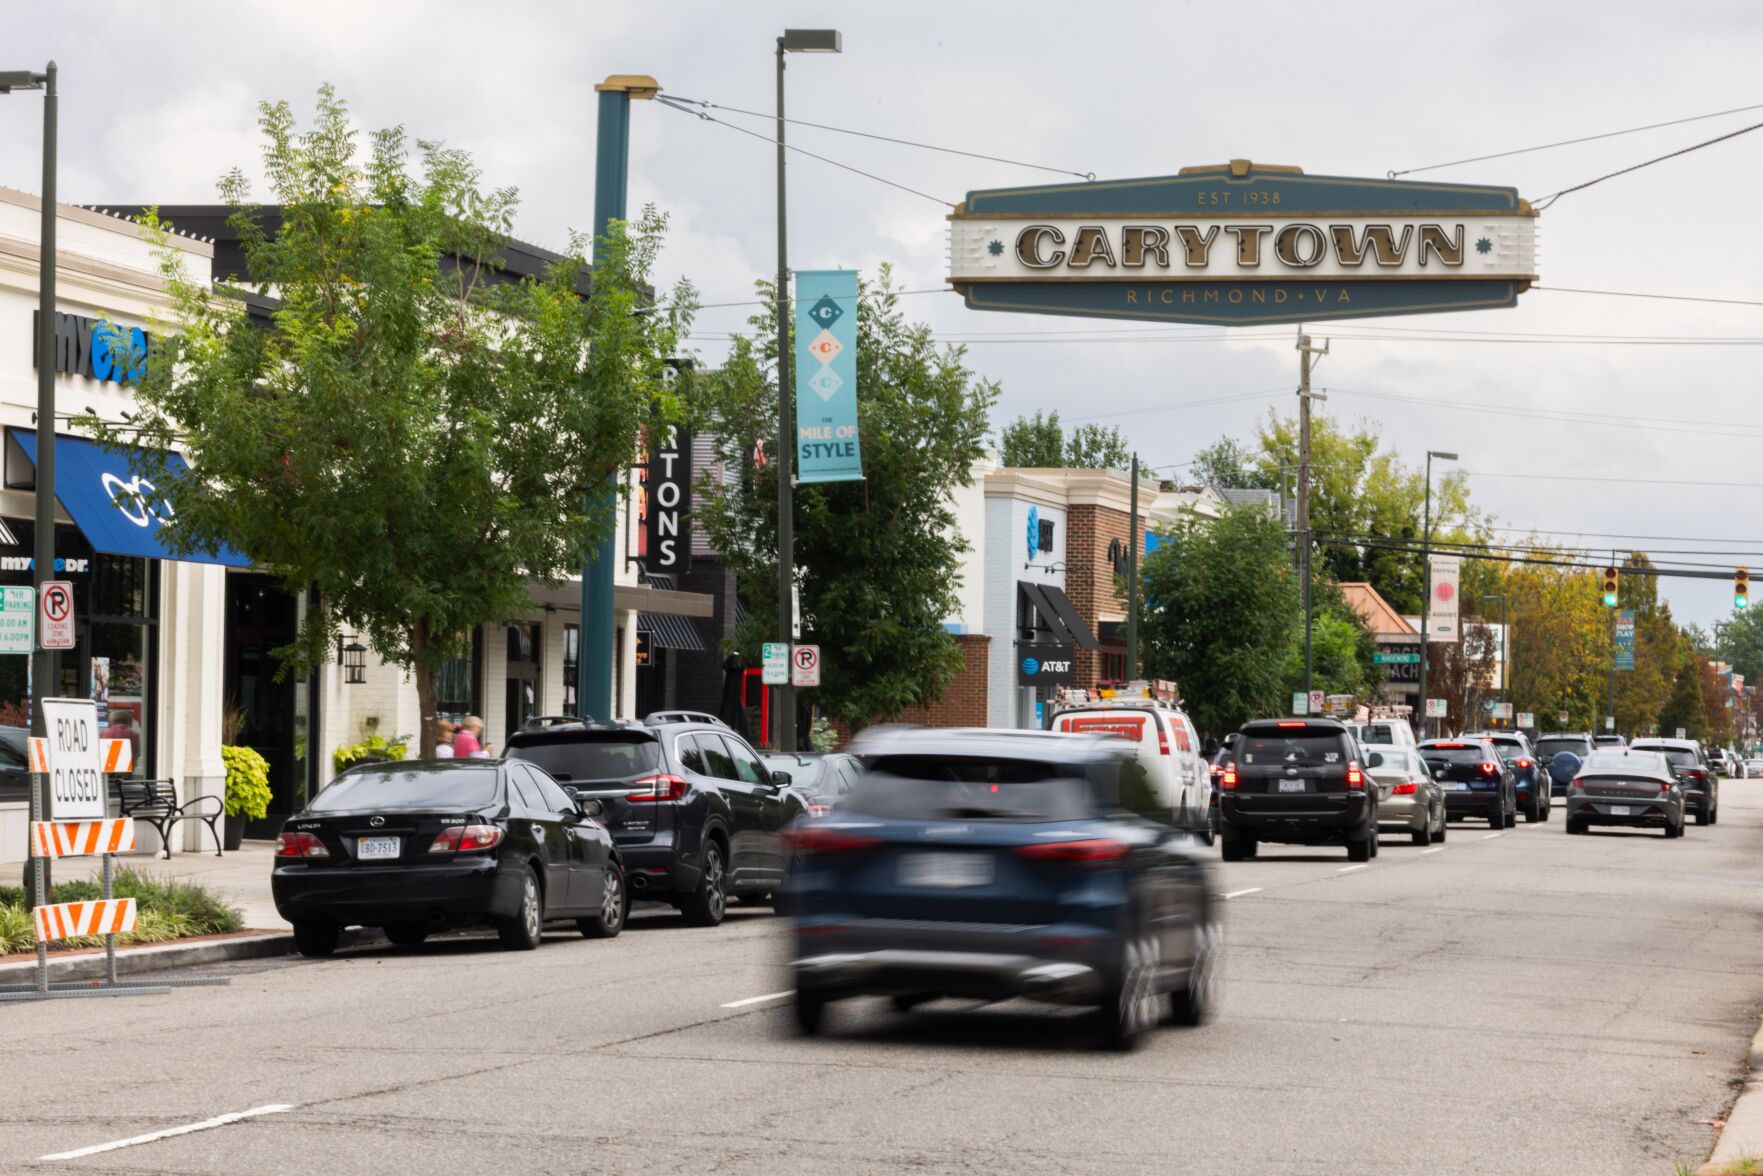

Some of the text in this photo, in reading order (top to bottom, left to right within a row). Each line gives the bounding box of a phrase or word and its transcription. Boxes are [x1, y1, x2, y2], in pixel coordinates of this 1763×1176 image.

[1198, 192, 1281, 205] EST 1938
[1015, 224, 1465, 269] CARYTOWN
[1126, 289, 1352, 305] RICHMOND VA
[800, 426, 858, 440] MILE OF
[801, 443, 856, 460] STYLE
[656, 366, 681, 566] BRTONS
[5, 601, 32, 609] PARKING
[1041, 661, 1071, 672] AT&T
[57, 718, 88, 752] ROAD
[55, 768, 98, 802] CLOSED
